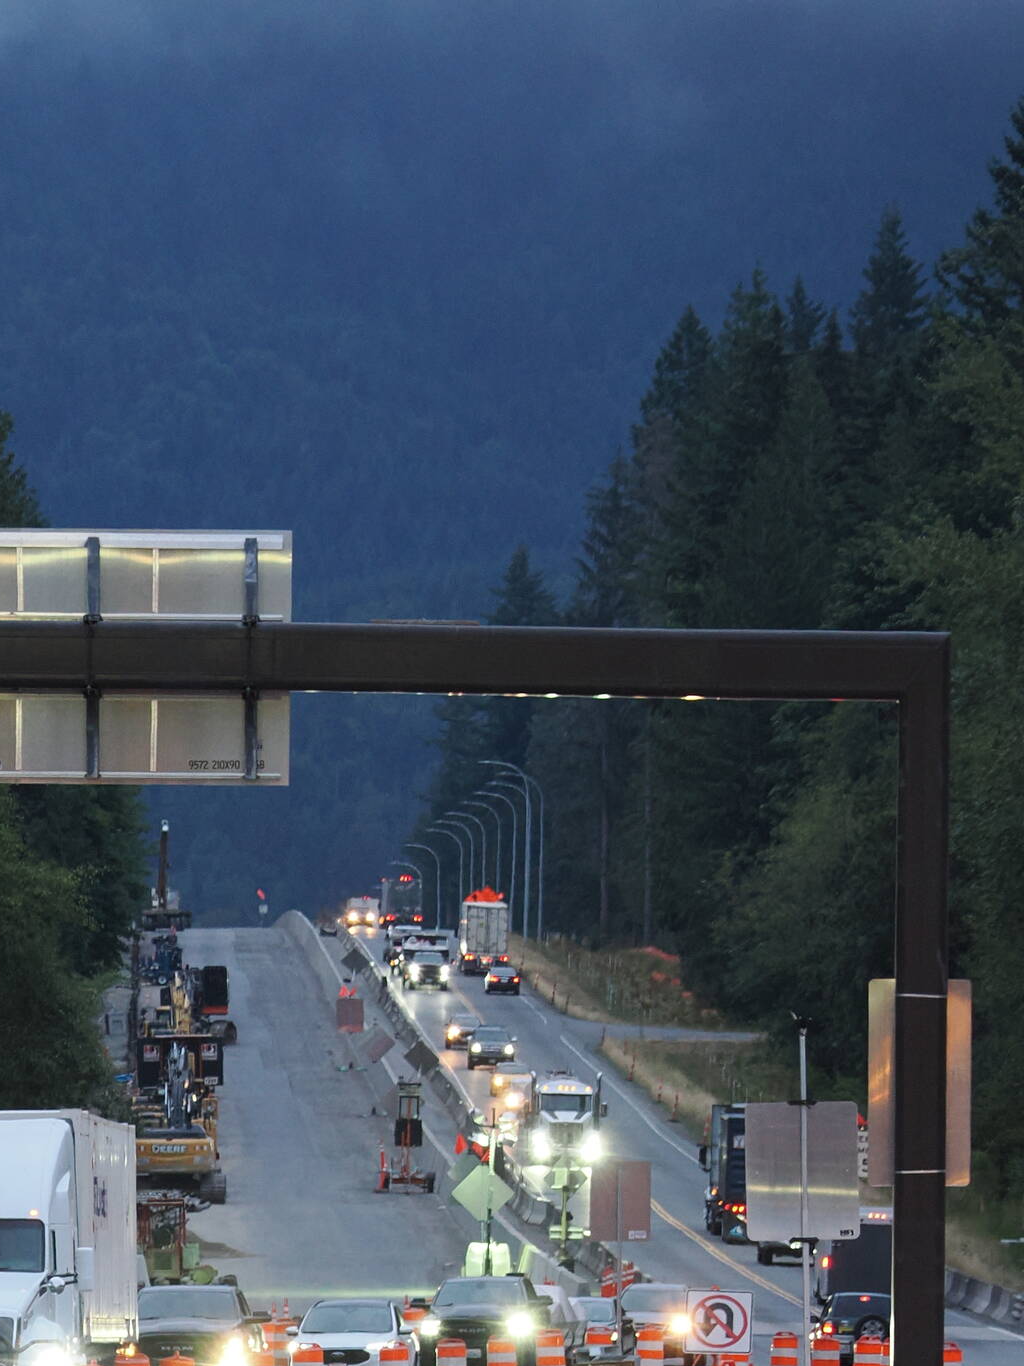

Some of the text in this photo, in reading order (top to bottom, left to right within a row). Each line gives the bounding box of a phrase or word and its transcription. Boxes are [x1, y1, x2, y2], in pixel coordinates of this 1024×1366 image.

[188, 760, 208, 769] 9572
[212, 760, 240, 769] 210X90
[152, 1144, 188, 1154] DEERE
